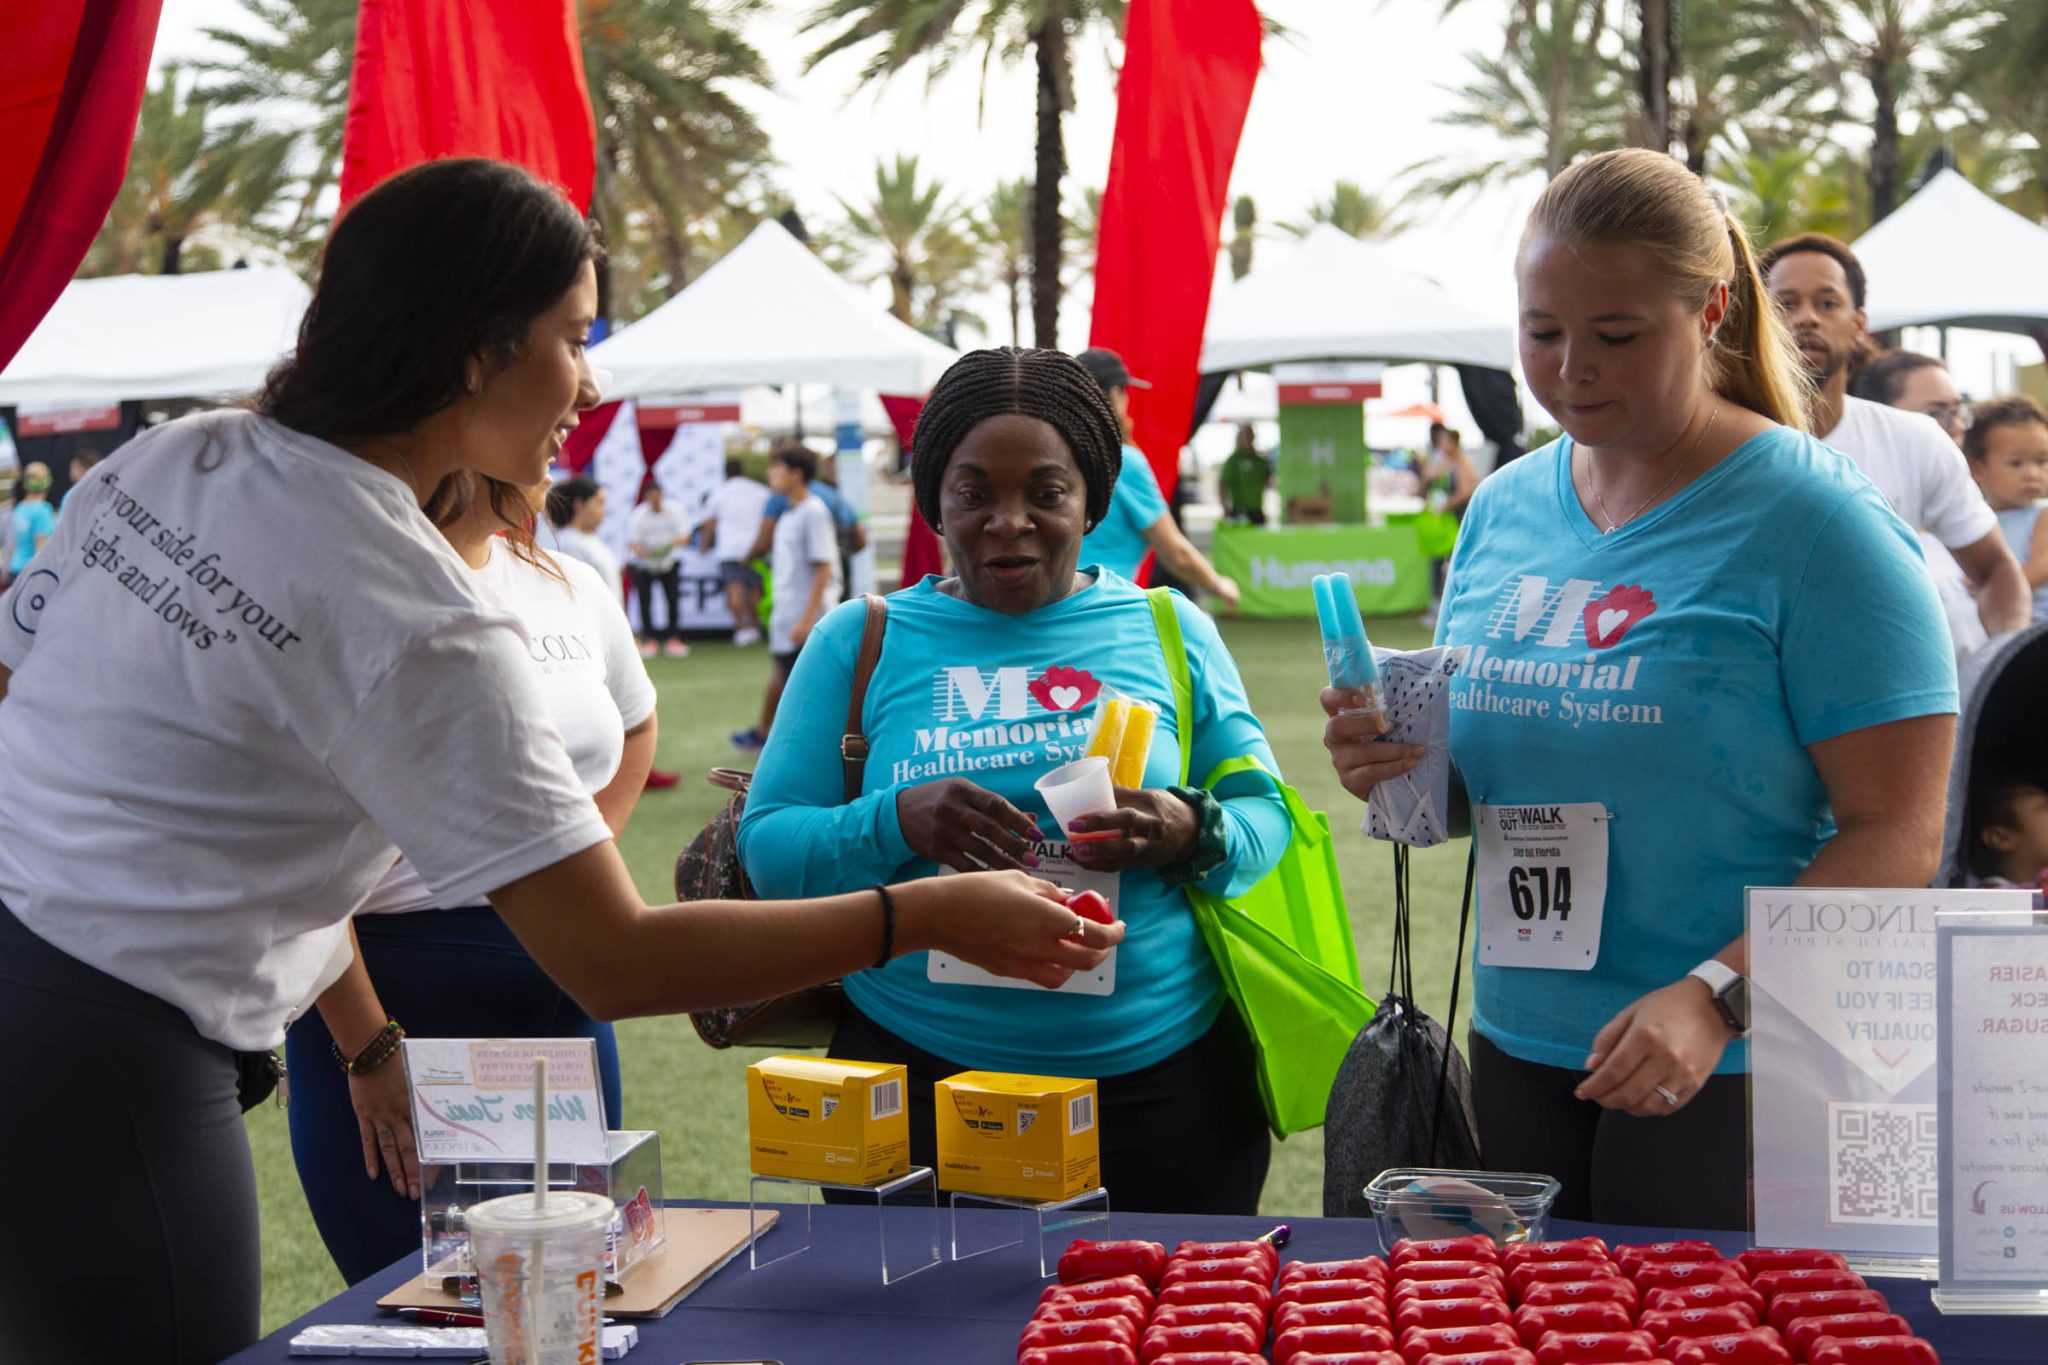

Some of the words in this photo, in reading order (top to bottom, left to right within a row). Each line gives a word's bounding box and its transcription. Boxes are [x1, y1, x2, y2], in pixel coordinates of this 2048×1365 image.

[103, 489, 161, 535] your
[151, 526, 196, 566] side
[186, 553, 234, 596] for
[216, 589, 301, 652] your
[117, 564, 169, 605] and
[1453, 644, 1643, 691] Memorial
[1559, 691, 1664, 729] System
[912, 714, 1094, 756] Memoria
[892, 749, 1036, 785] Healthcare
[1045, 740, 1087, 765] Sys
[1500, 818, 1518, 831] OUT
[1518, 806, 1563, 823] WALK
[1508, 865, 1572, 921] 674
